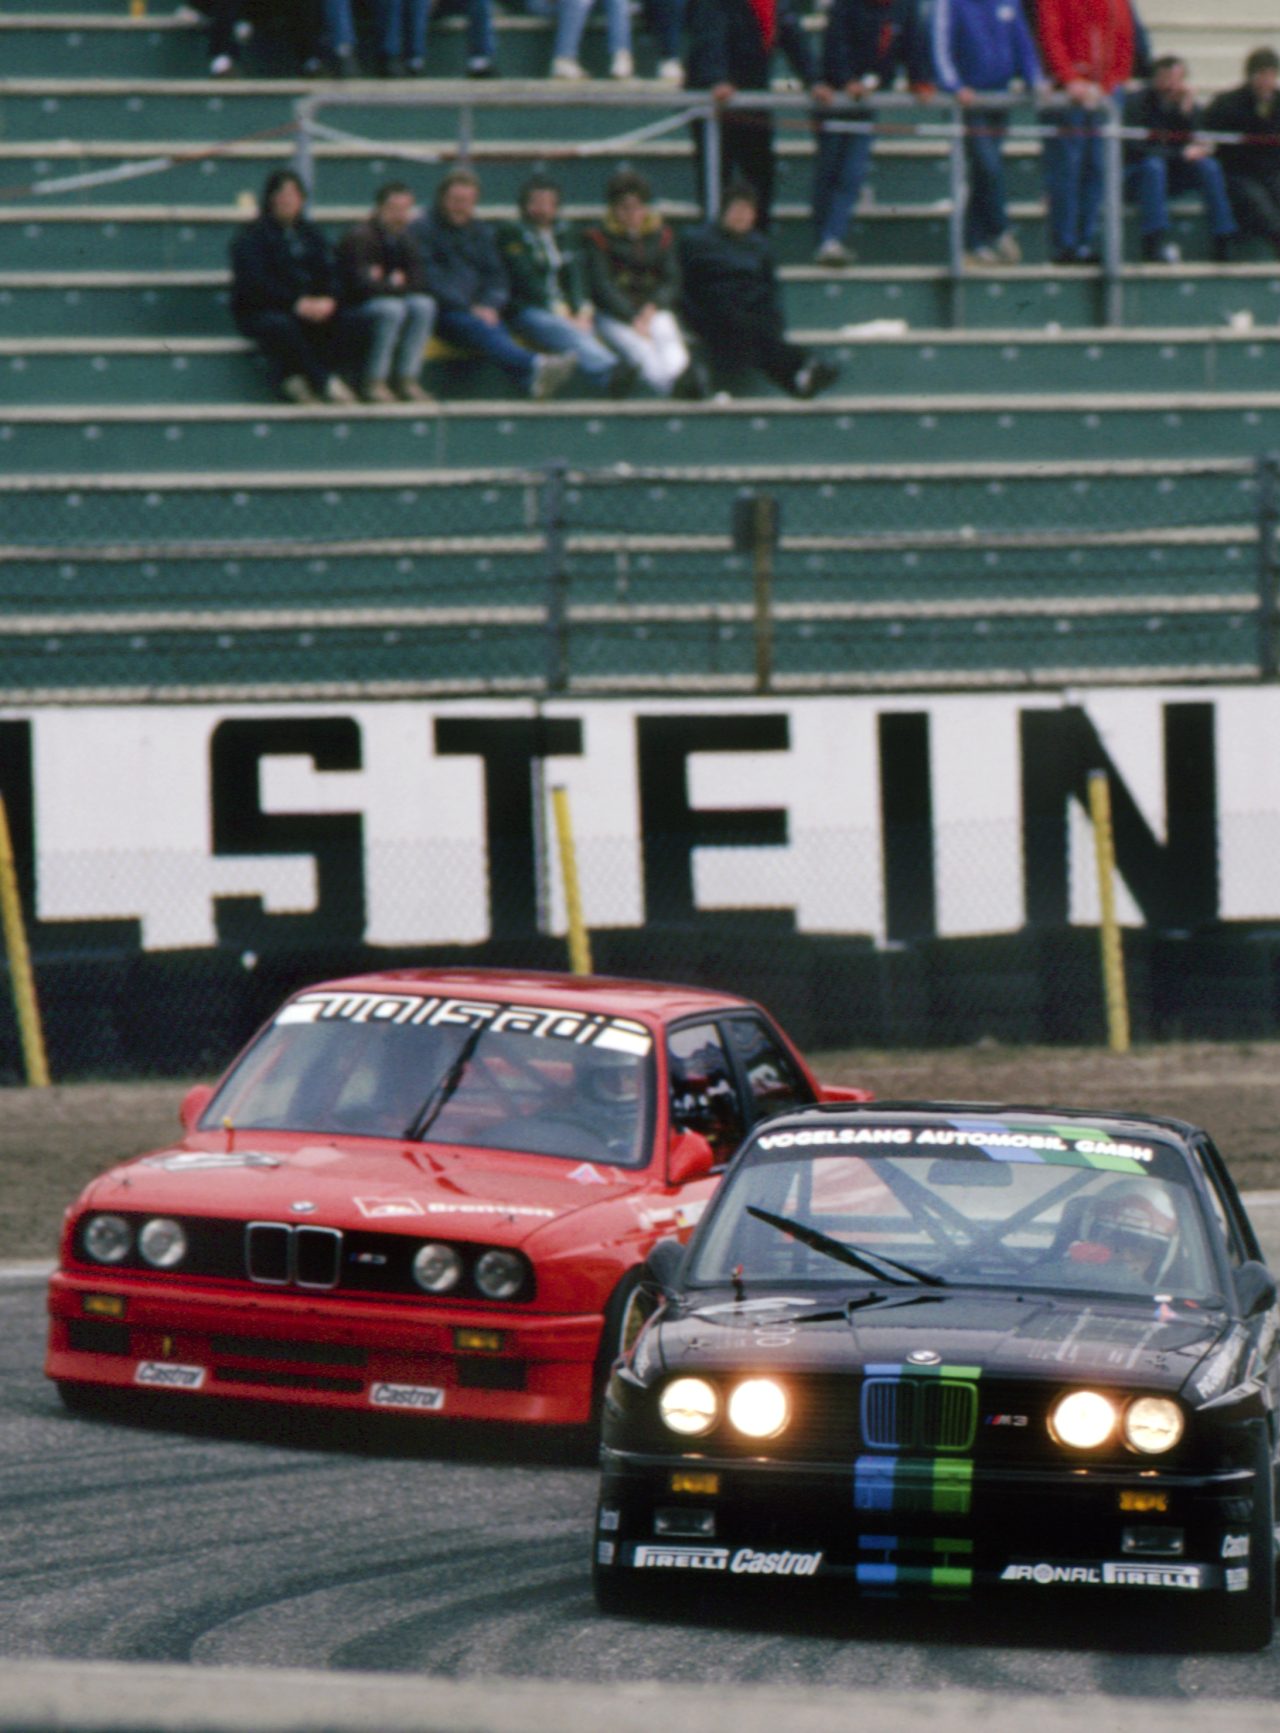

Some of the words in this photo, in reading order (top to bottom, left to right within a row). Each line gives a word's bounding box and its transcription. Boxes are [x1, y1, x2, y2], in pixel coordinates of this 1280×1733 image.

[758, 1128, 912, 1150] VOGELSANG
[916, 1128, 1067, 1151] AUTOMOBIL
[1074, 1139, 1154, 1162] GMBH
[633, 1545, 731, 1570] PIRELLI
[730, 1547, 824, 1577] Castrol
[1103, 1561, 1201, 1589] PIRELLI
